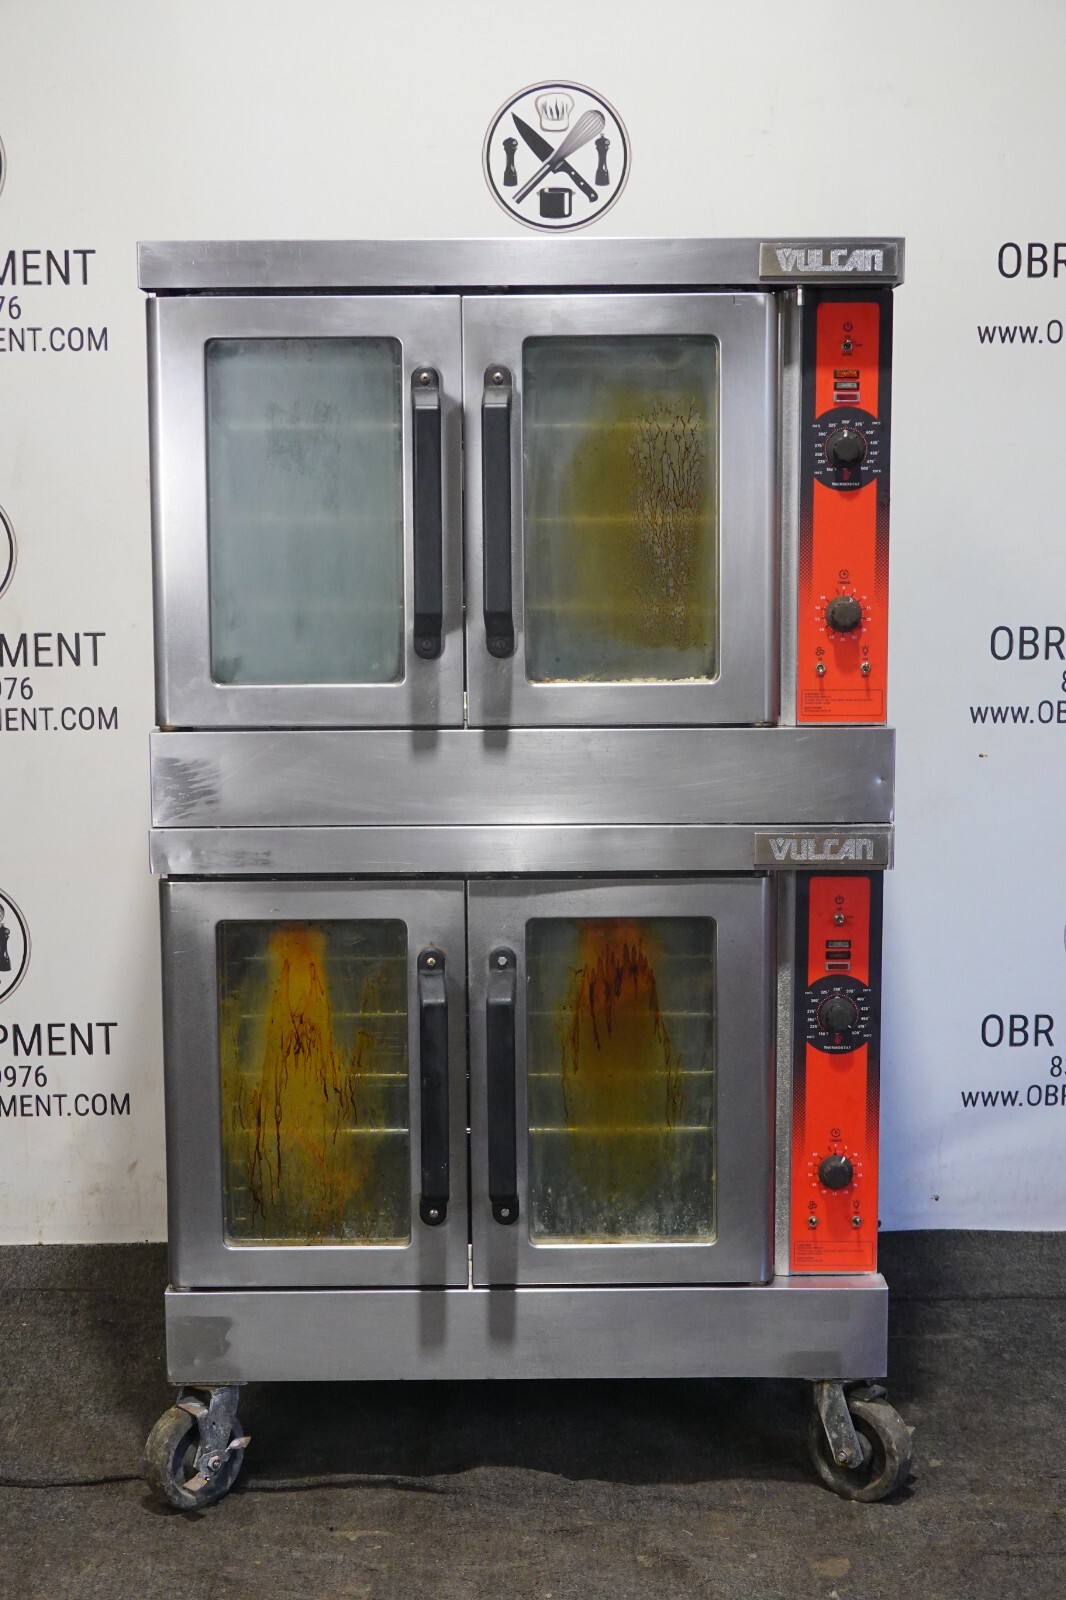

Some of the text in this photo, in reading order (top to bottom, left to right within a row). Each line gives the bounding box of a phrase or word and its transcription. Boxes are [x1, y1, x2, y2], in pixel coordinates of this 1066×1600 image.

[775, 248, 884, 272] VULCAN
[998, 242, 1066, 278] OBR
[977, 319, 1064, 344] www.O
[0, 632, 106, 668] MENT
[990, 626, 1066, 661] OBR
[0, 706, 118, 731] ENT.COM
[769, 838, 874, 860] VULCAN
[981, 1014, 1055, 1047] OBR
[1050, 1055, 1066, 1077] 8
[0, 1093, 131, 1117] MENT.COM
